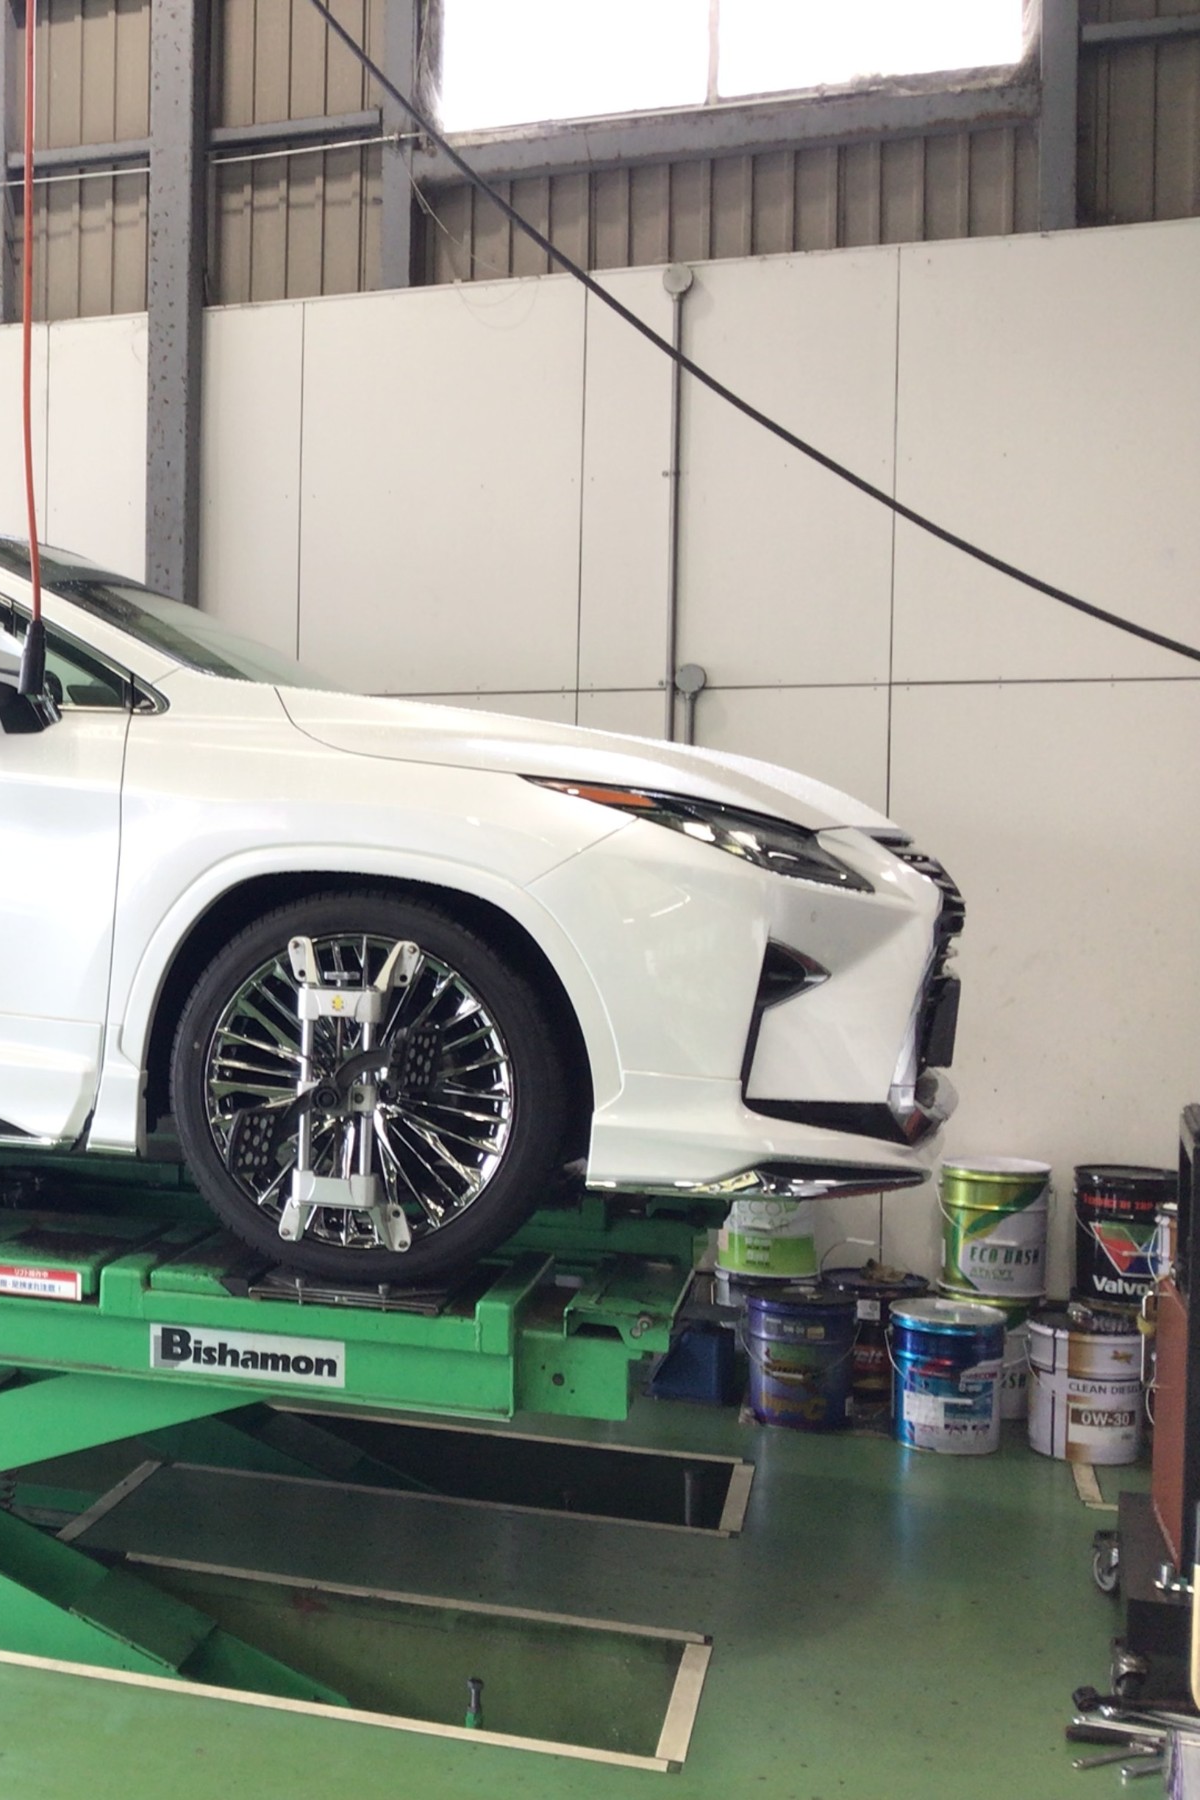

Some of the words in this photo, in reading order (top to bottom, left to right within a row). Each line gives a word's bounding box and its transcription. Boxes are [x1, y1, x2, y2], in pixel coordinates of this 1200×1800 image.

[970, 1246, 998, 1263] ECO
[1092, 1275, 1151, 1296] Valvo
[160, 1326, 338, 1378] Bishamon
[1068, 1382, 1107, 1395] CLEAN
[1080, 1410, 1130, 1427] 0W-30
